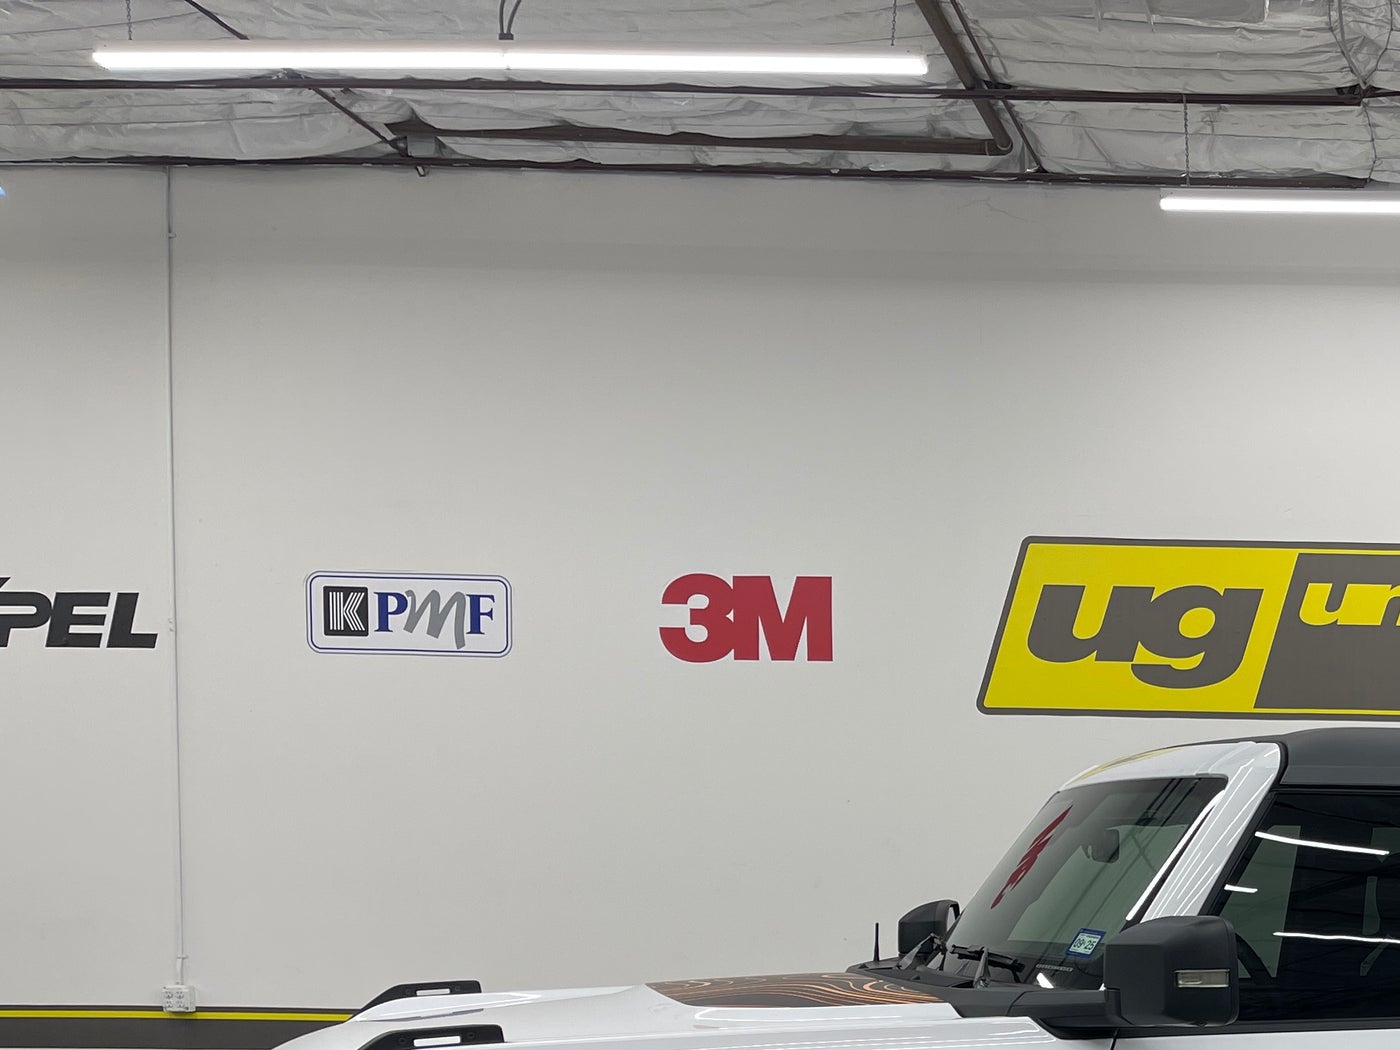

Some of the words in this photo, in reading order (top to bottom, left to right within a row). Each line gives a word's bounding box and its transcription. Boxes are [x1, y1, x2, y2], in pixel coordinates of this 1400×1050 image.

[0, 576, 158, 649] PEL
[659, 573, 833, 663] 3M
[1027, 584, 1265, 689] ug
